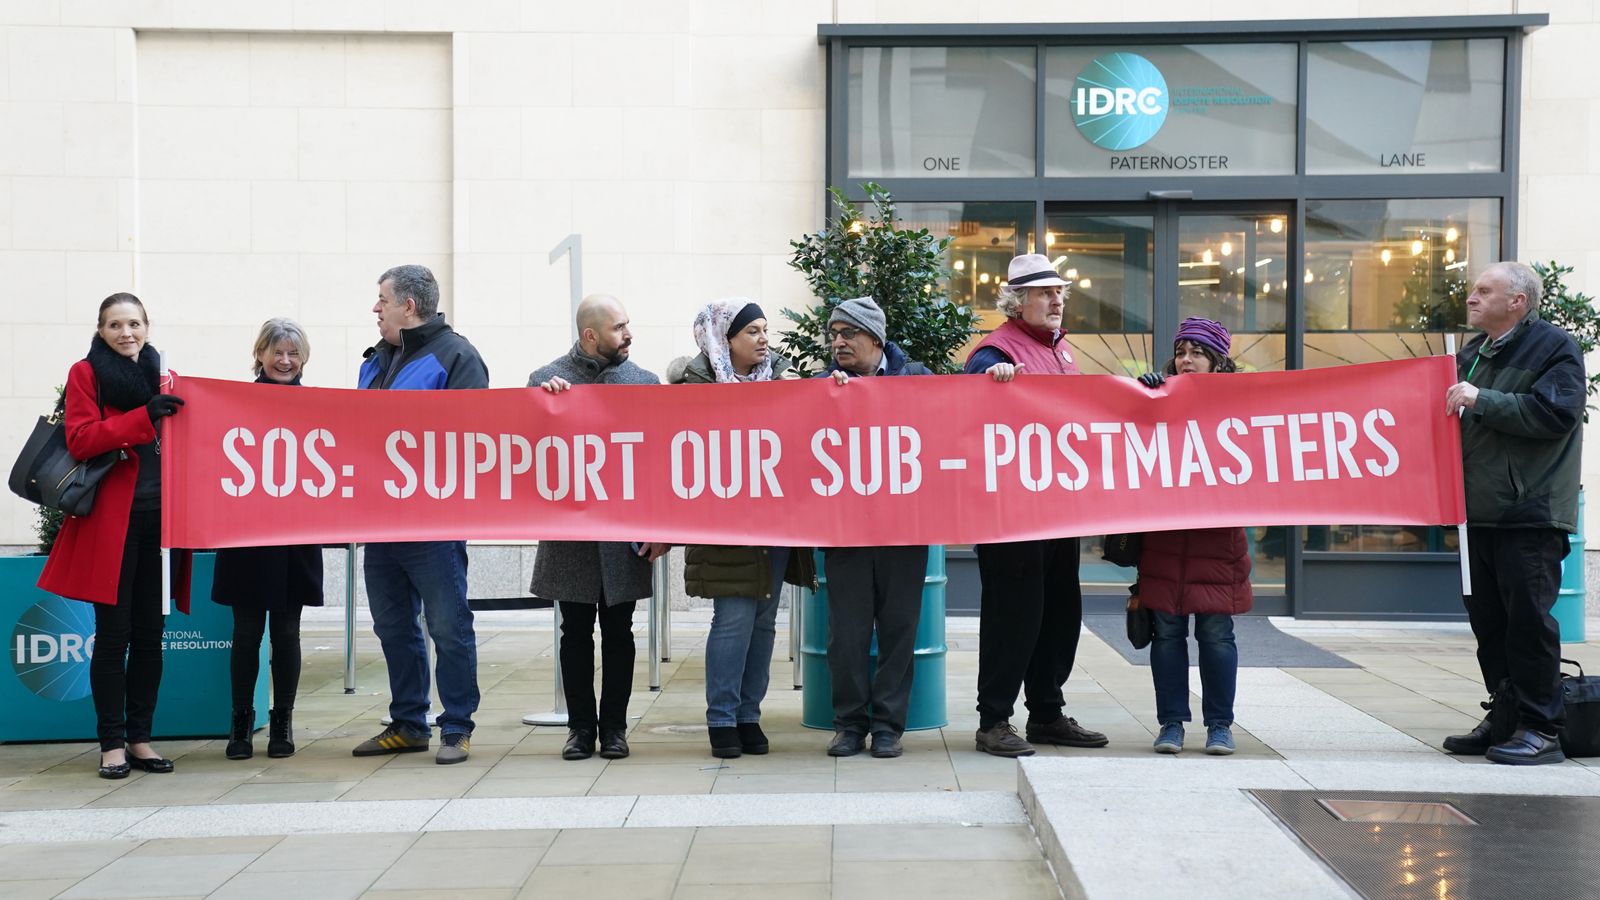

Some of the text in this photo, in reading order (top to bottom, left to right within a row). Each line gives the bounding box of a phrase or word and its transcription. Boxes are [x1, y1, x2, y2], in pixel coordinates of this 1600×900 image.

[1077, 87, 1162, 115] IDRC
[923, 153, 1426, 171] ONE PATERNOSTER LANE
[221, 428, 353, 498] SOS:
[384, 431, 643, 501] SUPPORT
[671, 430, 783, 499] OUR
[811, 426, 922, 496] SUB
[984, 409, 1399, 492] POSTMASTERS
[162, 630, 203, 640] ATIONAL
[170, 640, 233, 650] RESOLUTION
